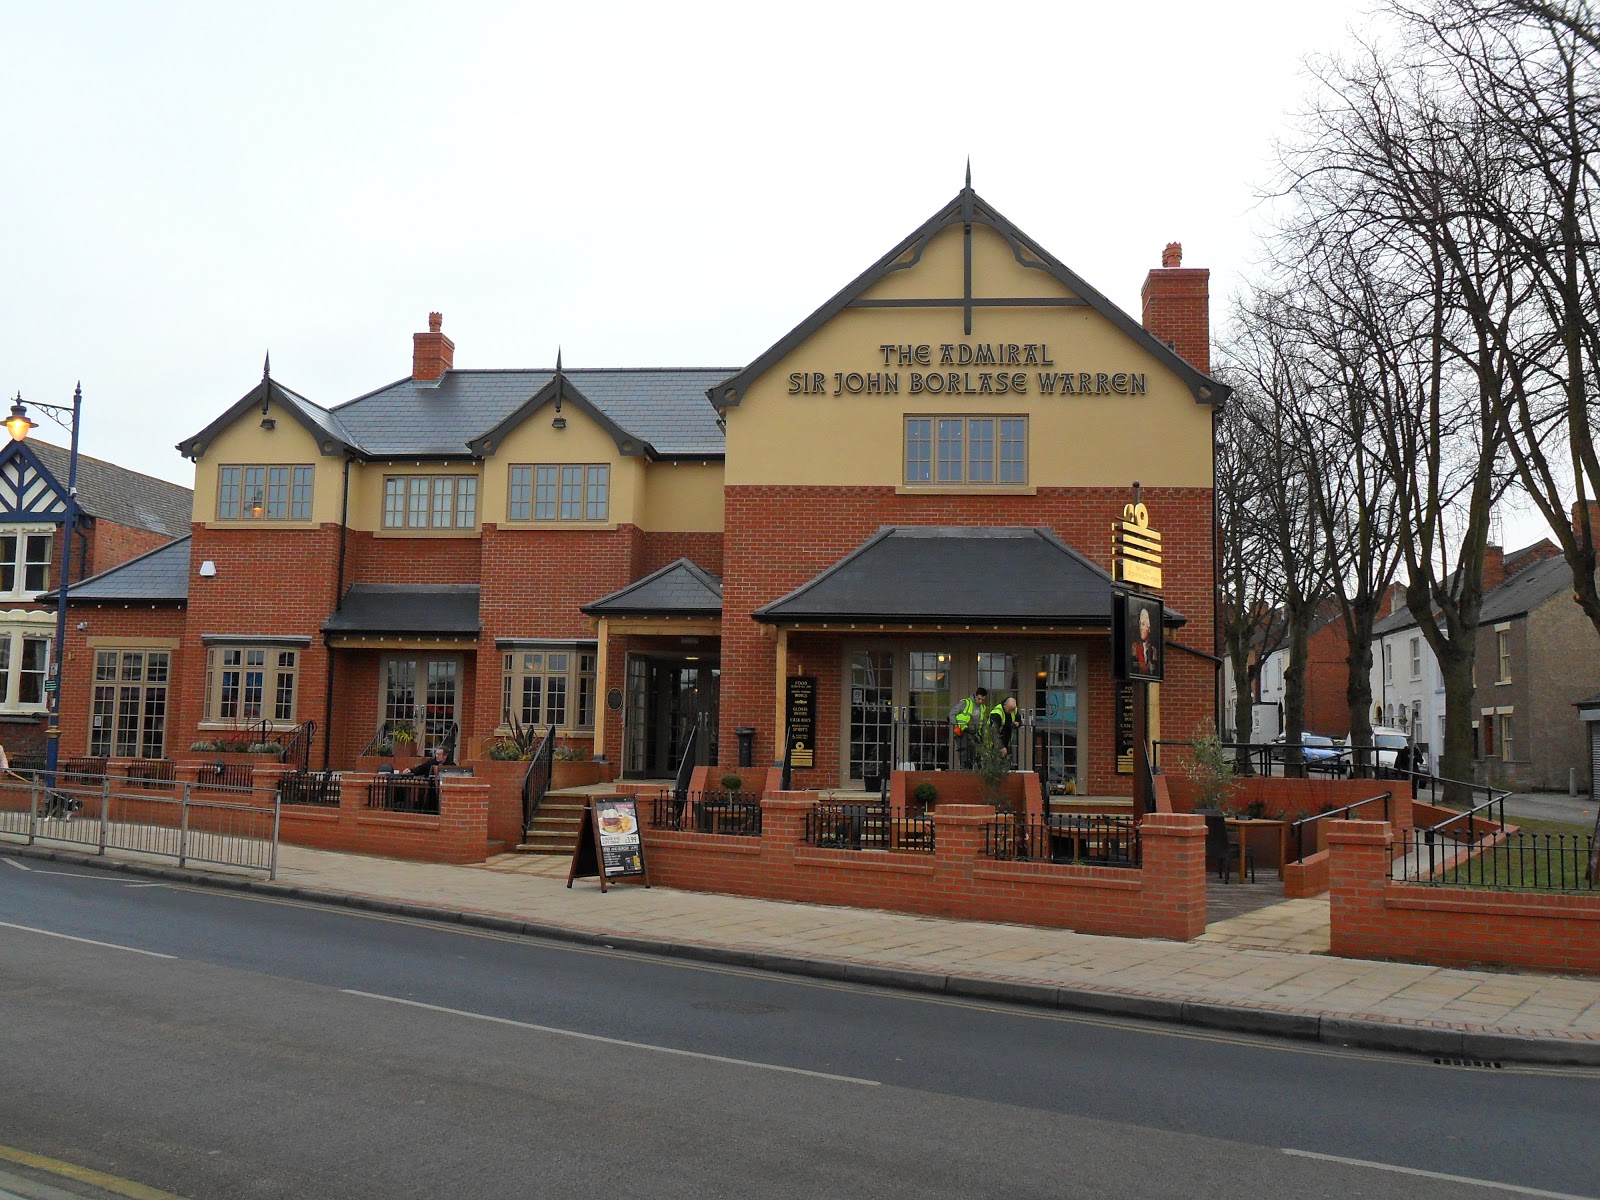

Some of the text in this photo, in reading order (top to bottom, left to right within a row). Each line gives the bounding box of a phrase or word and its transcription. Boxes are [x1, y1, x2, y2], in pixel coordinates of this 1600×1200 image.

[880, 344, 1054, 365] THE ADMIRAL
[788, 372, 1147, 396] SIR JOHN BORLASE WARREN
